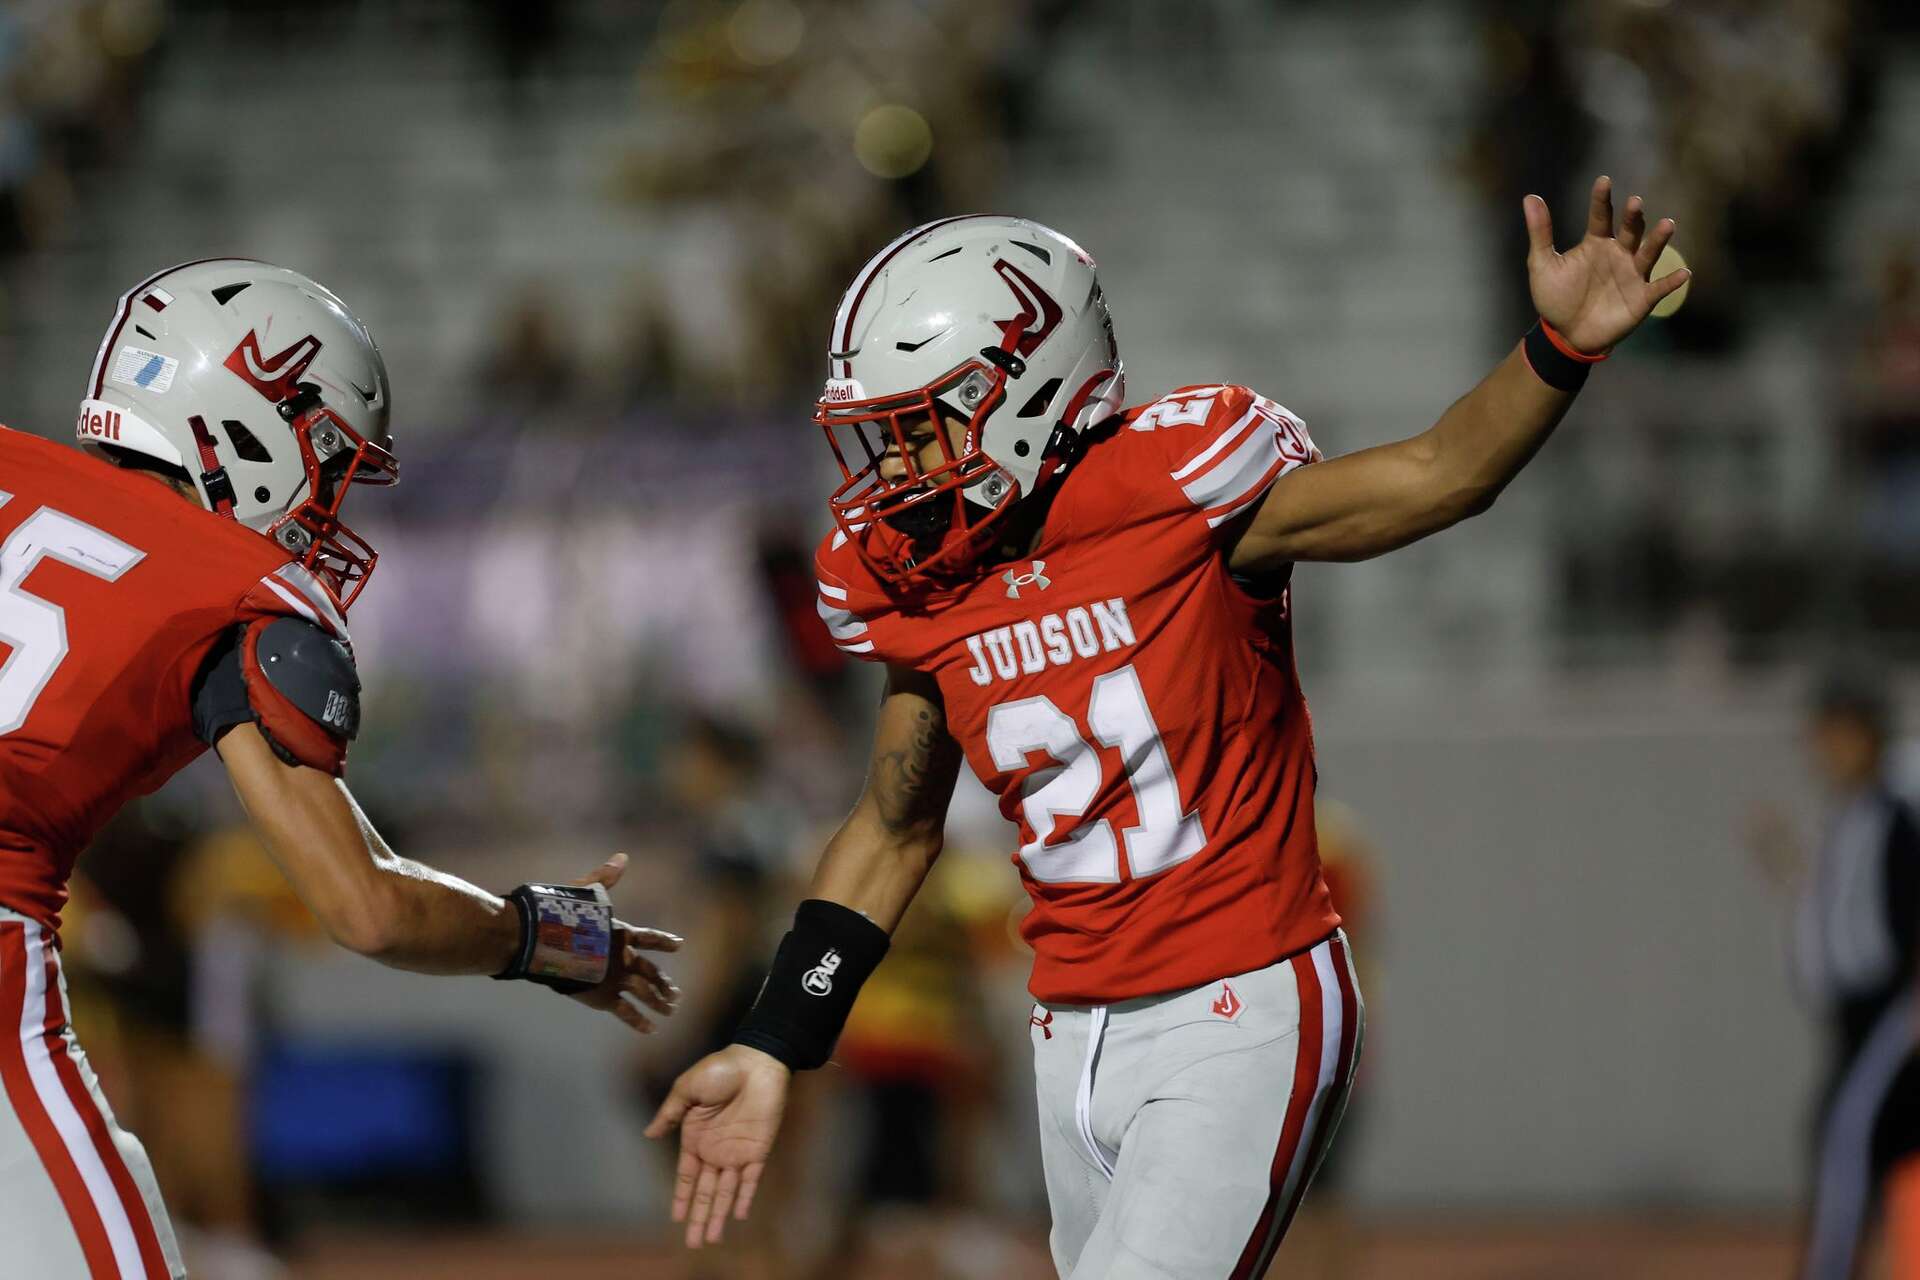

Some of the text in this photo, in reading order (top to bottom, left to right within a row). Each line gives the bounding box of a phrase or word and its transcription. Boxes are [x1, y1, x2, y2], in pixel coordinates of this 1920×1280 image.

[77, 407, 121, 440] dell
[0, 487, 148, 737] 5
[966, 597, 1137, 687] JUDSON
[986, 664, 1208, 884] 21
[805, 951, 842, 990] TAG
